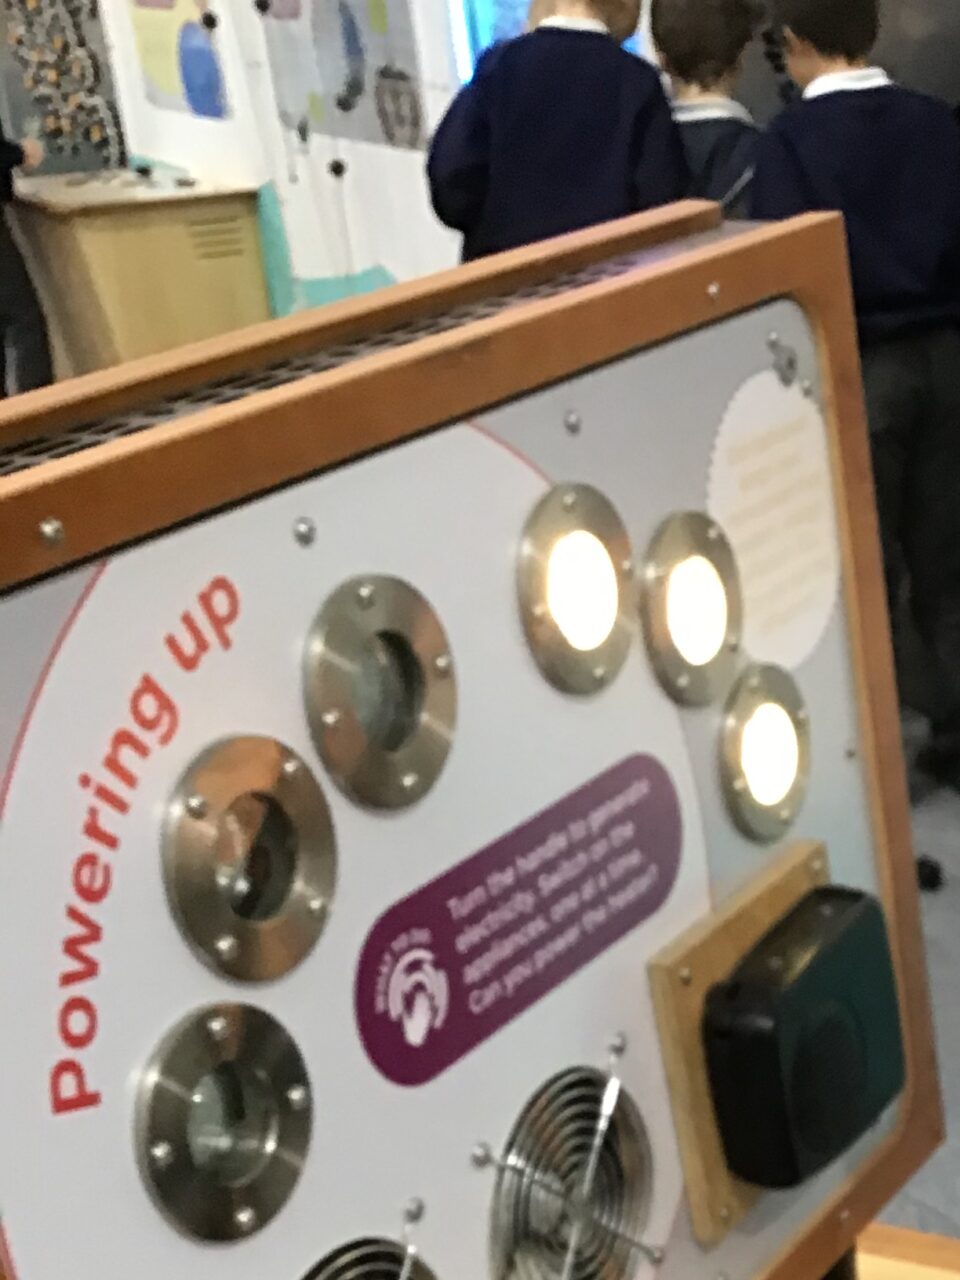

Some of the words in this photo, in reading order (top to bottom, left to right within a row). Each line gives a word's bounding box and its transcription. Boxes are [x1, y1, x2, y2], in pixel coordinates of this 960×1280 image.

[49, 673, 179, 1115] Powering
[164, 574, 240, 672] up
[468, 981, 502, 1015] Can
